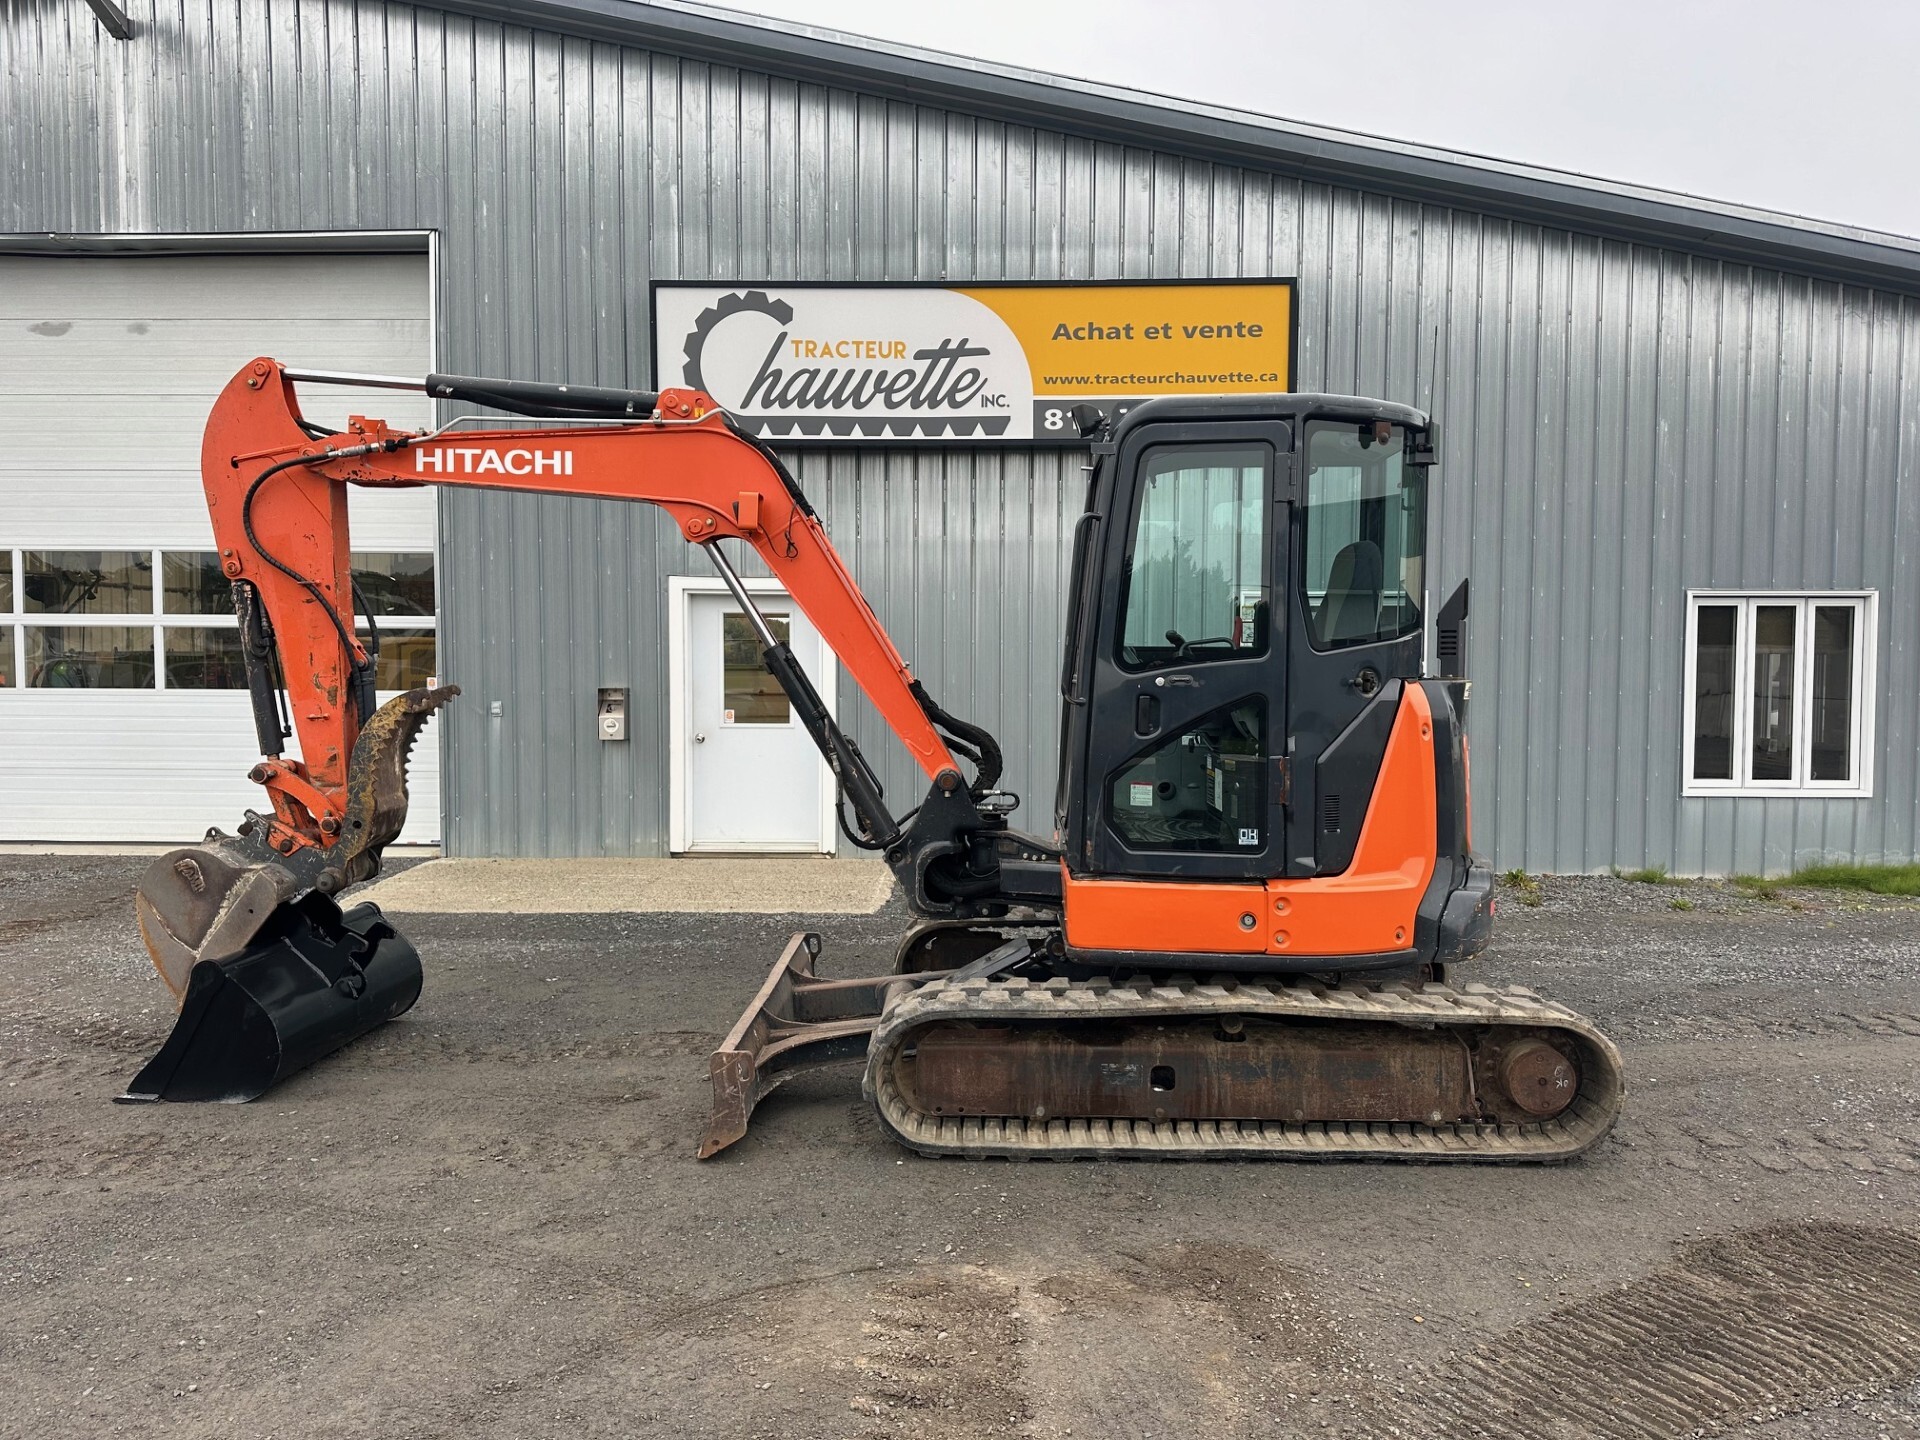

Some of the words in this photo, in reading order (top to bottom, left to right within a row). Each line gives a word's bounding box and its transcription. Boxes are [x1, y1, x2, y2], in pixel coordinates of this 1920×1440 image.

[1051, 321, 1134, 341] Achat
[1144, 322, 1173, 340] et
[1182, 321, 1264, 339] vente
[682, 290, 991, 412] Chauvette
[980, 394, 1010, 409] INC.
[791, 339, 907, 360] TRACTEUR
[1043, 372, 1279, 385] www.tracteurchauvette.ca
[415, 447, 573, 476] HITACHI
